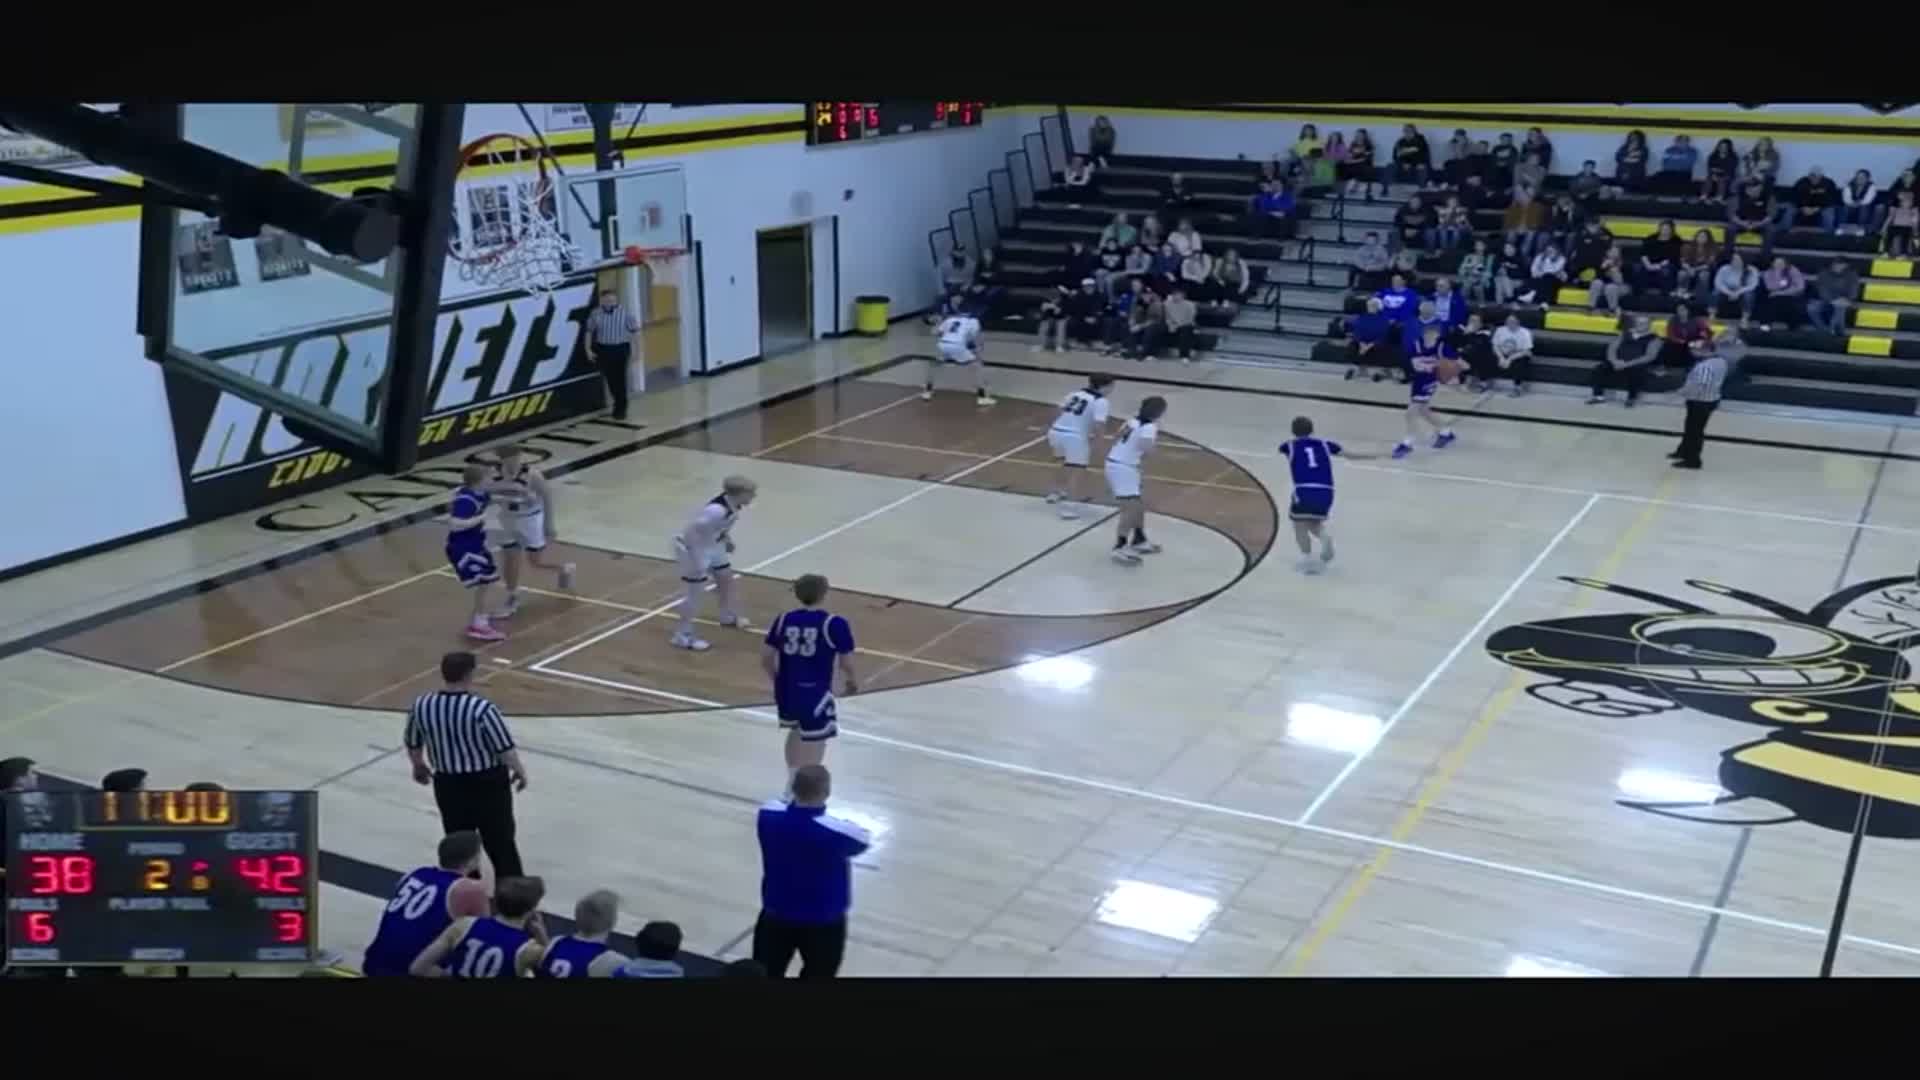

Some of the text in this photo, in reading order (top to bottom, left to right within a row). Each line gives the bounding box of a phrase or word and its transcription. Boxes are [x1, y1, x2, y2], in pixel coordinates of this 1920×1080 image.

[1303, 446, 1319, 468] 1
[783, 626, 818, 657] 33
[387, 877, 438, 919] 50
[458, 939, 504, 977] 10
